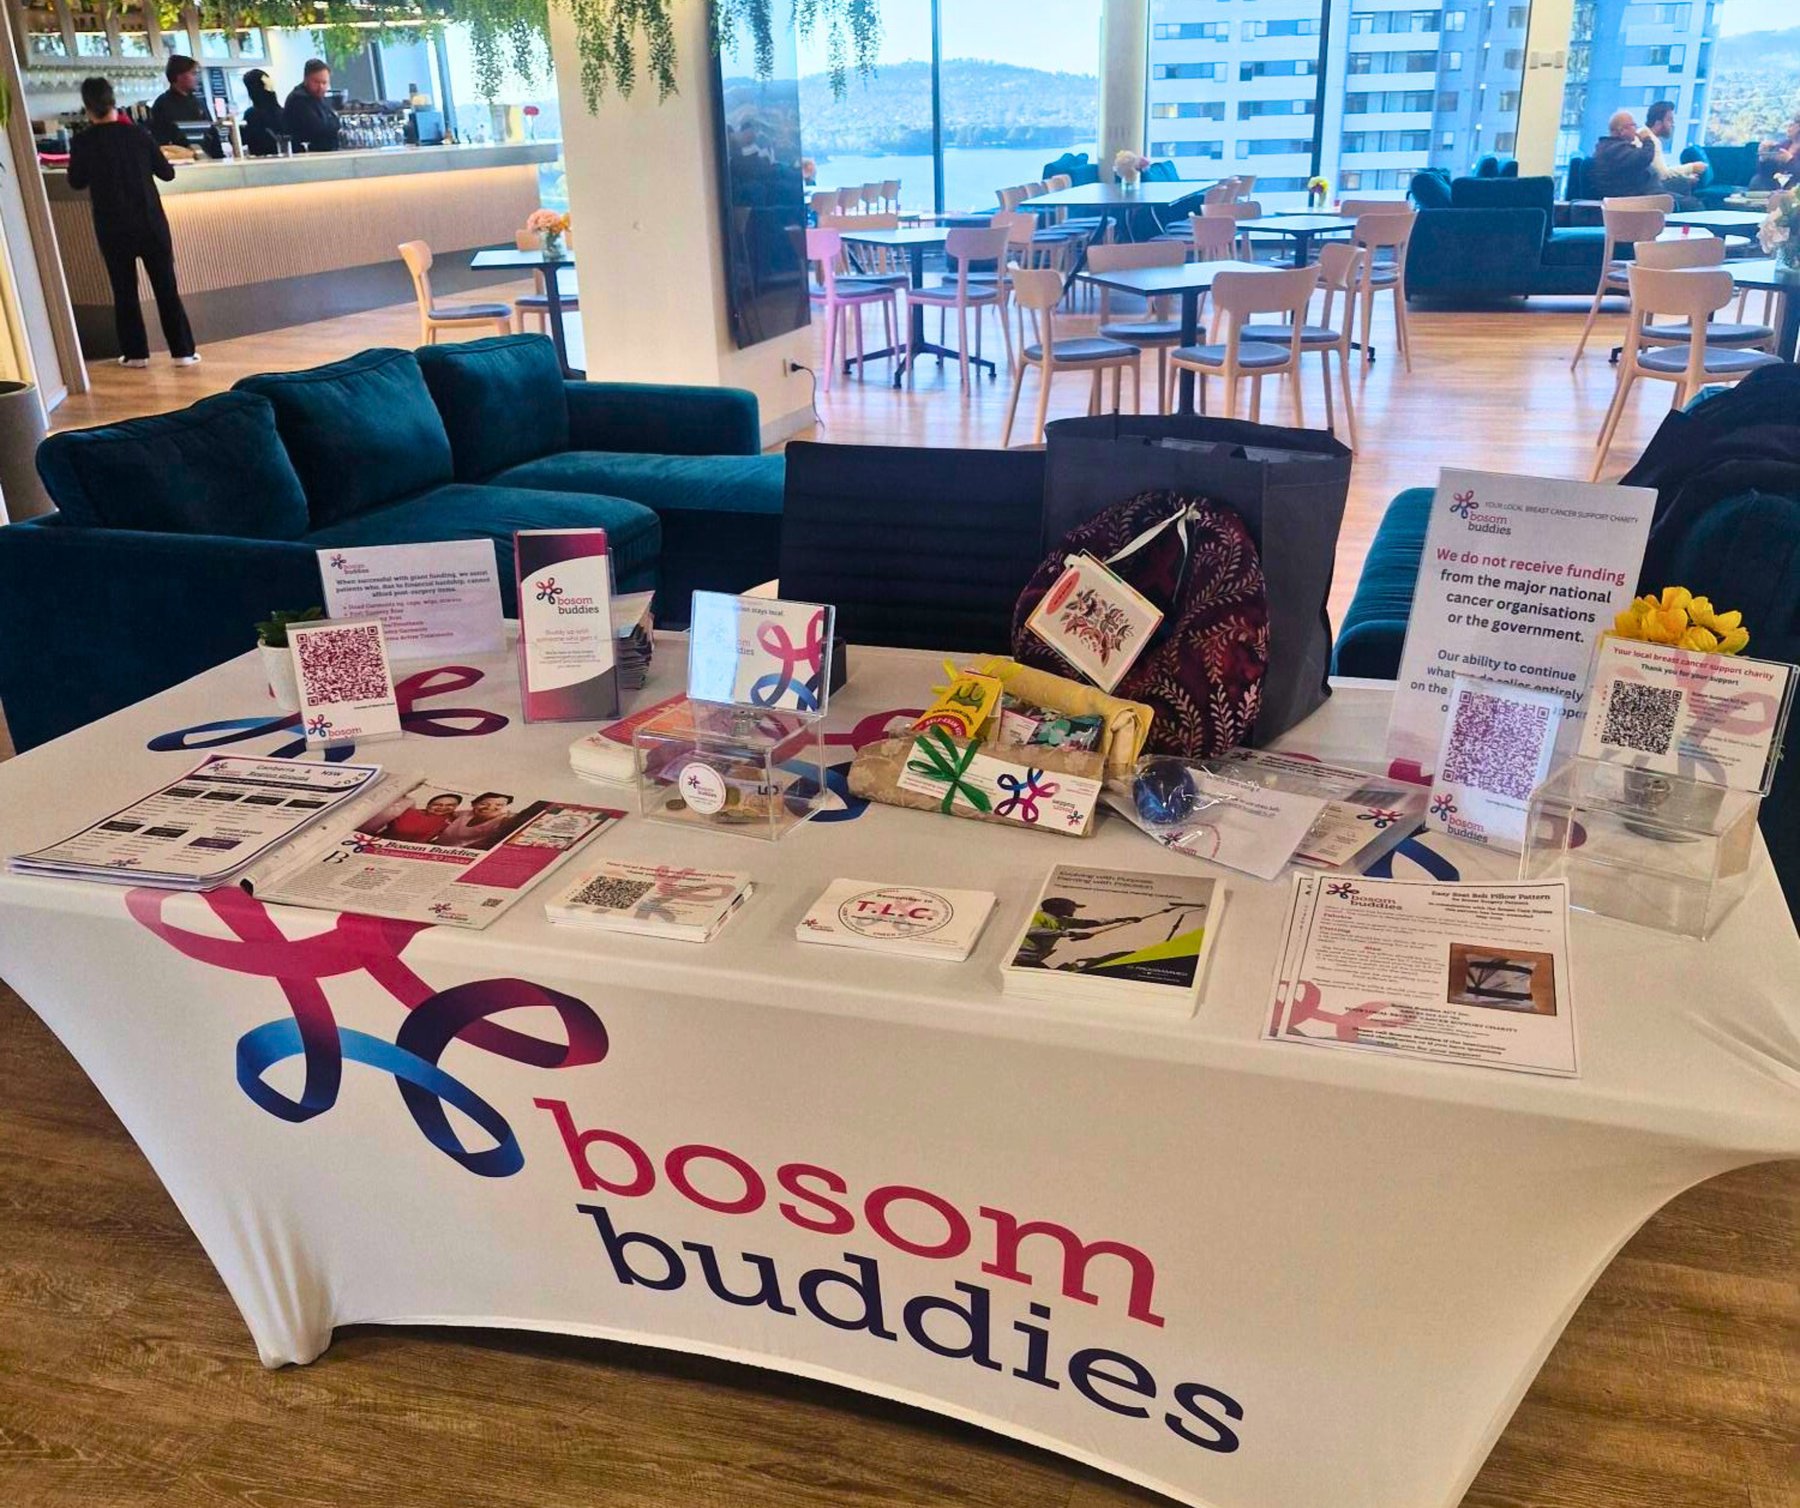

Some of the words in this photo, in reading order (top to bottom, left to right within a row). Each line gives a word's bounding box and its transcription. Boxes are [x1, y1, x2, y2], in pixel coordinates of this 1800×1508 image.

[1469, 511, 1507, 524] bosom
[1525, 506, 1549, 514] BREAST
[1551, 508, 1576, 517] CANCER
[1577, 512, 1608, 520] SUPPORT
[1609, 514, 1638, 524] CHARITY
[1468, 522, 1511, 535] buddies
[1437, 548, 1457, 561] We
[1461, 551, 1479, 564] do
[1482, 554, 1506, 568] not
[1510, 559, 1563, 575] receive
[1567, 564, 1626, 587] funding
[1441, 569, 1474, 585] from
[1478, 573, 1500, 588] the
[1504, 577, 1546, 595] major
[1549, 584, 1611, 604] national
[558, 597, 592, 605] bosom
[558, 605, 599, 614] buddies
[1446, 593, 1494, 608] cancer
[1496, 599, 1596, 623] organisations
[1448, 612, 1463, 623] or
[1466, 612, 1489, 628] the
[1491, 620, 1585, 643] government.
[1437, 649, 1460, 662] Our
[1462, 654, 1500, 672] ability
[1503, 660, 1517, 671] to
[1520, 662, 1576, 682] continue
[1613, 647, 1632, 656] Your
[1633, 650, 1652, 661] local
[1653, 653, 1679, 664] breast
[1680, 659, 1708, 669] cancer
[1710, 664, 1742, 676] support
[1744, 669, 1774, 682] charity
[1641, 663, 1662, 673] Thank
[1663, 667, 1677, 676] you
[1679, 669, 1690, 677] for
[1691, 672, 1709, 681] your
[1410, 681, 1425, 691] on
[1428, 681, 1448, 695] the
[1427, 666, 1455, 679] what
[1534, 684, 1584, 701] entirely
[328, 728, 362, 737] bosom
[1449, 814, 1484, 831] bosom
[1447, 824, 1488, 843] buddies
[385, 842, 427, 852] Bosom
[429, 847, 481, 858] Buddies
[1350, 900, 1402, 911] buddies
[1351, 895, 1396, 904] bosom
[857, 900, 933, 921] T.L.C.
[532, 1097, 1165, 1328] bosom
[576, 1204, 1244, 1453] buddies
